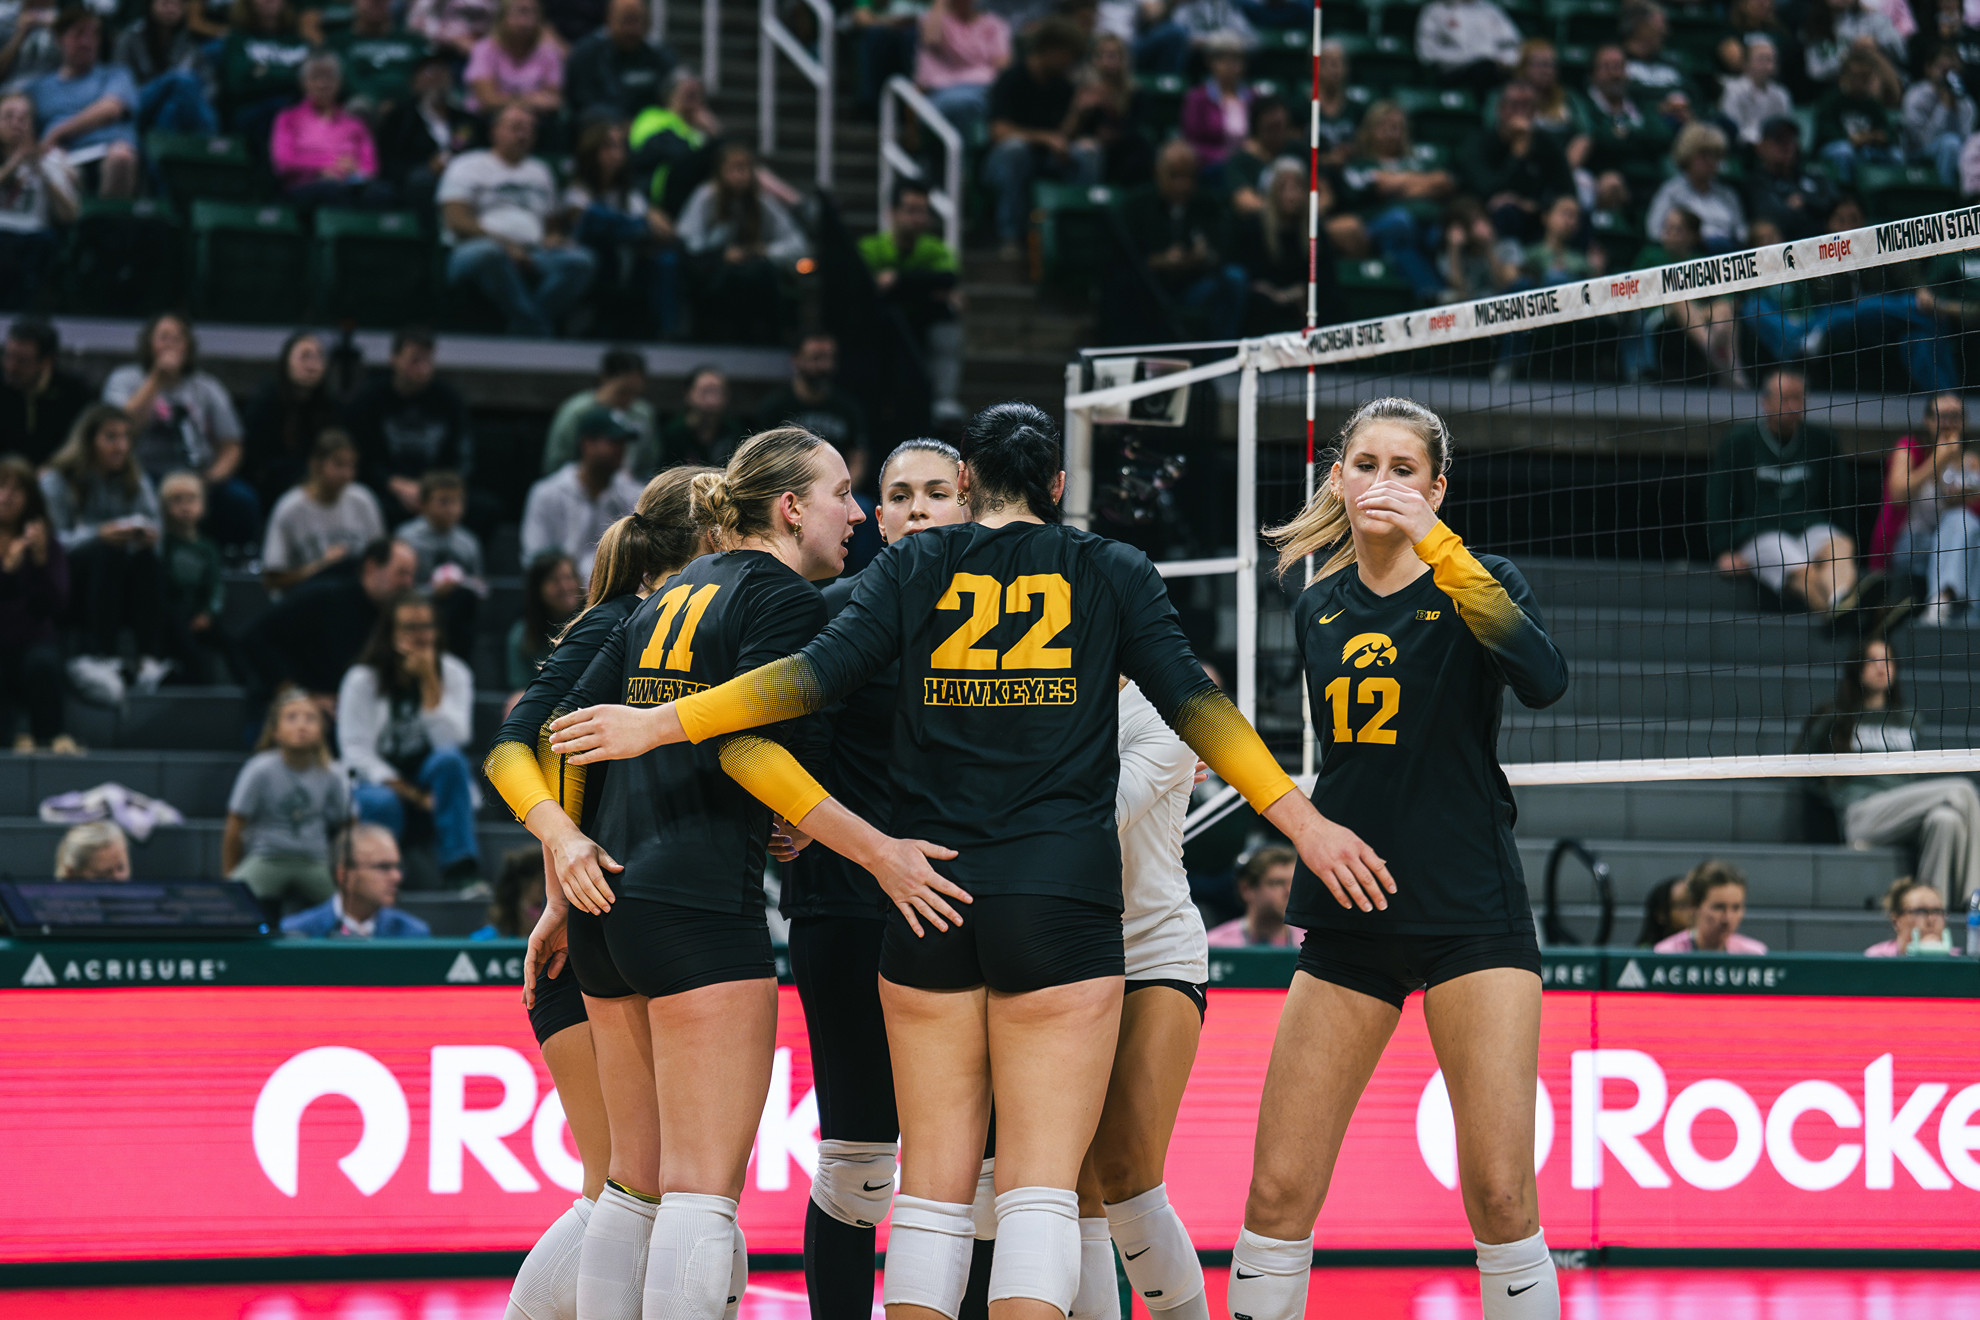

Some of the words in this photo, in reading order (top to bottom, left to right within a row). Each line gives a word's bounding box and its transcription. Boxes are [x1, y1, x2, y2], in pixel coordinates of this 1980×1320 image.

[1818, 235, 1852, 262] meijer
[1875, 214, 1945, 255] MICHIGAN
[1610, 275, 1640, 300] meijer
[1661, 257, 1722, 294] MICHIGAN
[1722, 251, 1760, 283] STATE
[1428, 310, 1456, 332] meijer
[1475, 294, 1527, 328] MICHIGAN
[1527, 289, 1560, 318] STATE
[1356, 321, 1385, 347] STATE
[638, 583, 721, 673] 11
[931, 572, 1072, 671] 22
[626, 676, 711, 706] AWKEYE
[924, 677, 1077, 707] HAWKEYES
[1325, 676, 1401, 745] 12
[63, 959, 218, 981] ACRISURE
[1651, 966, 1779, 988] ACRISURE
